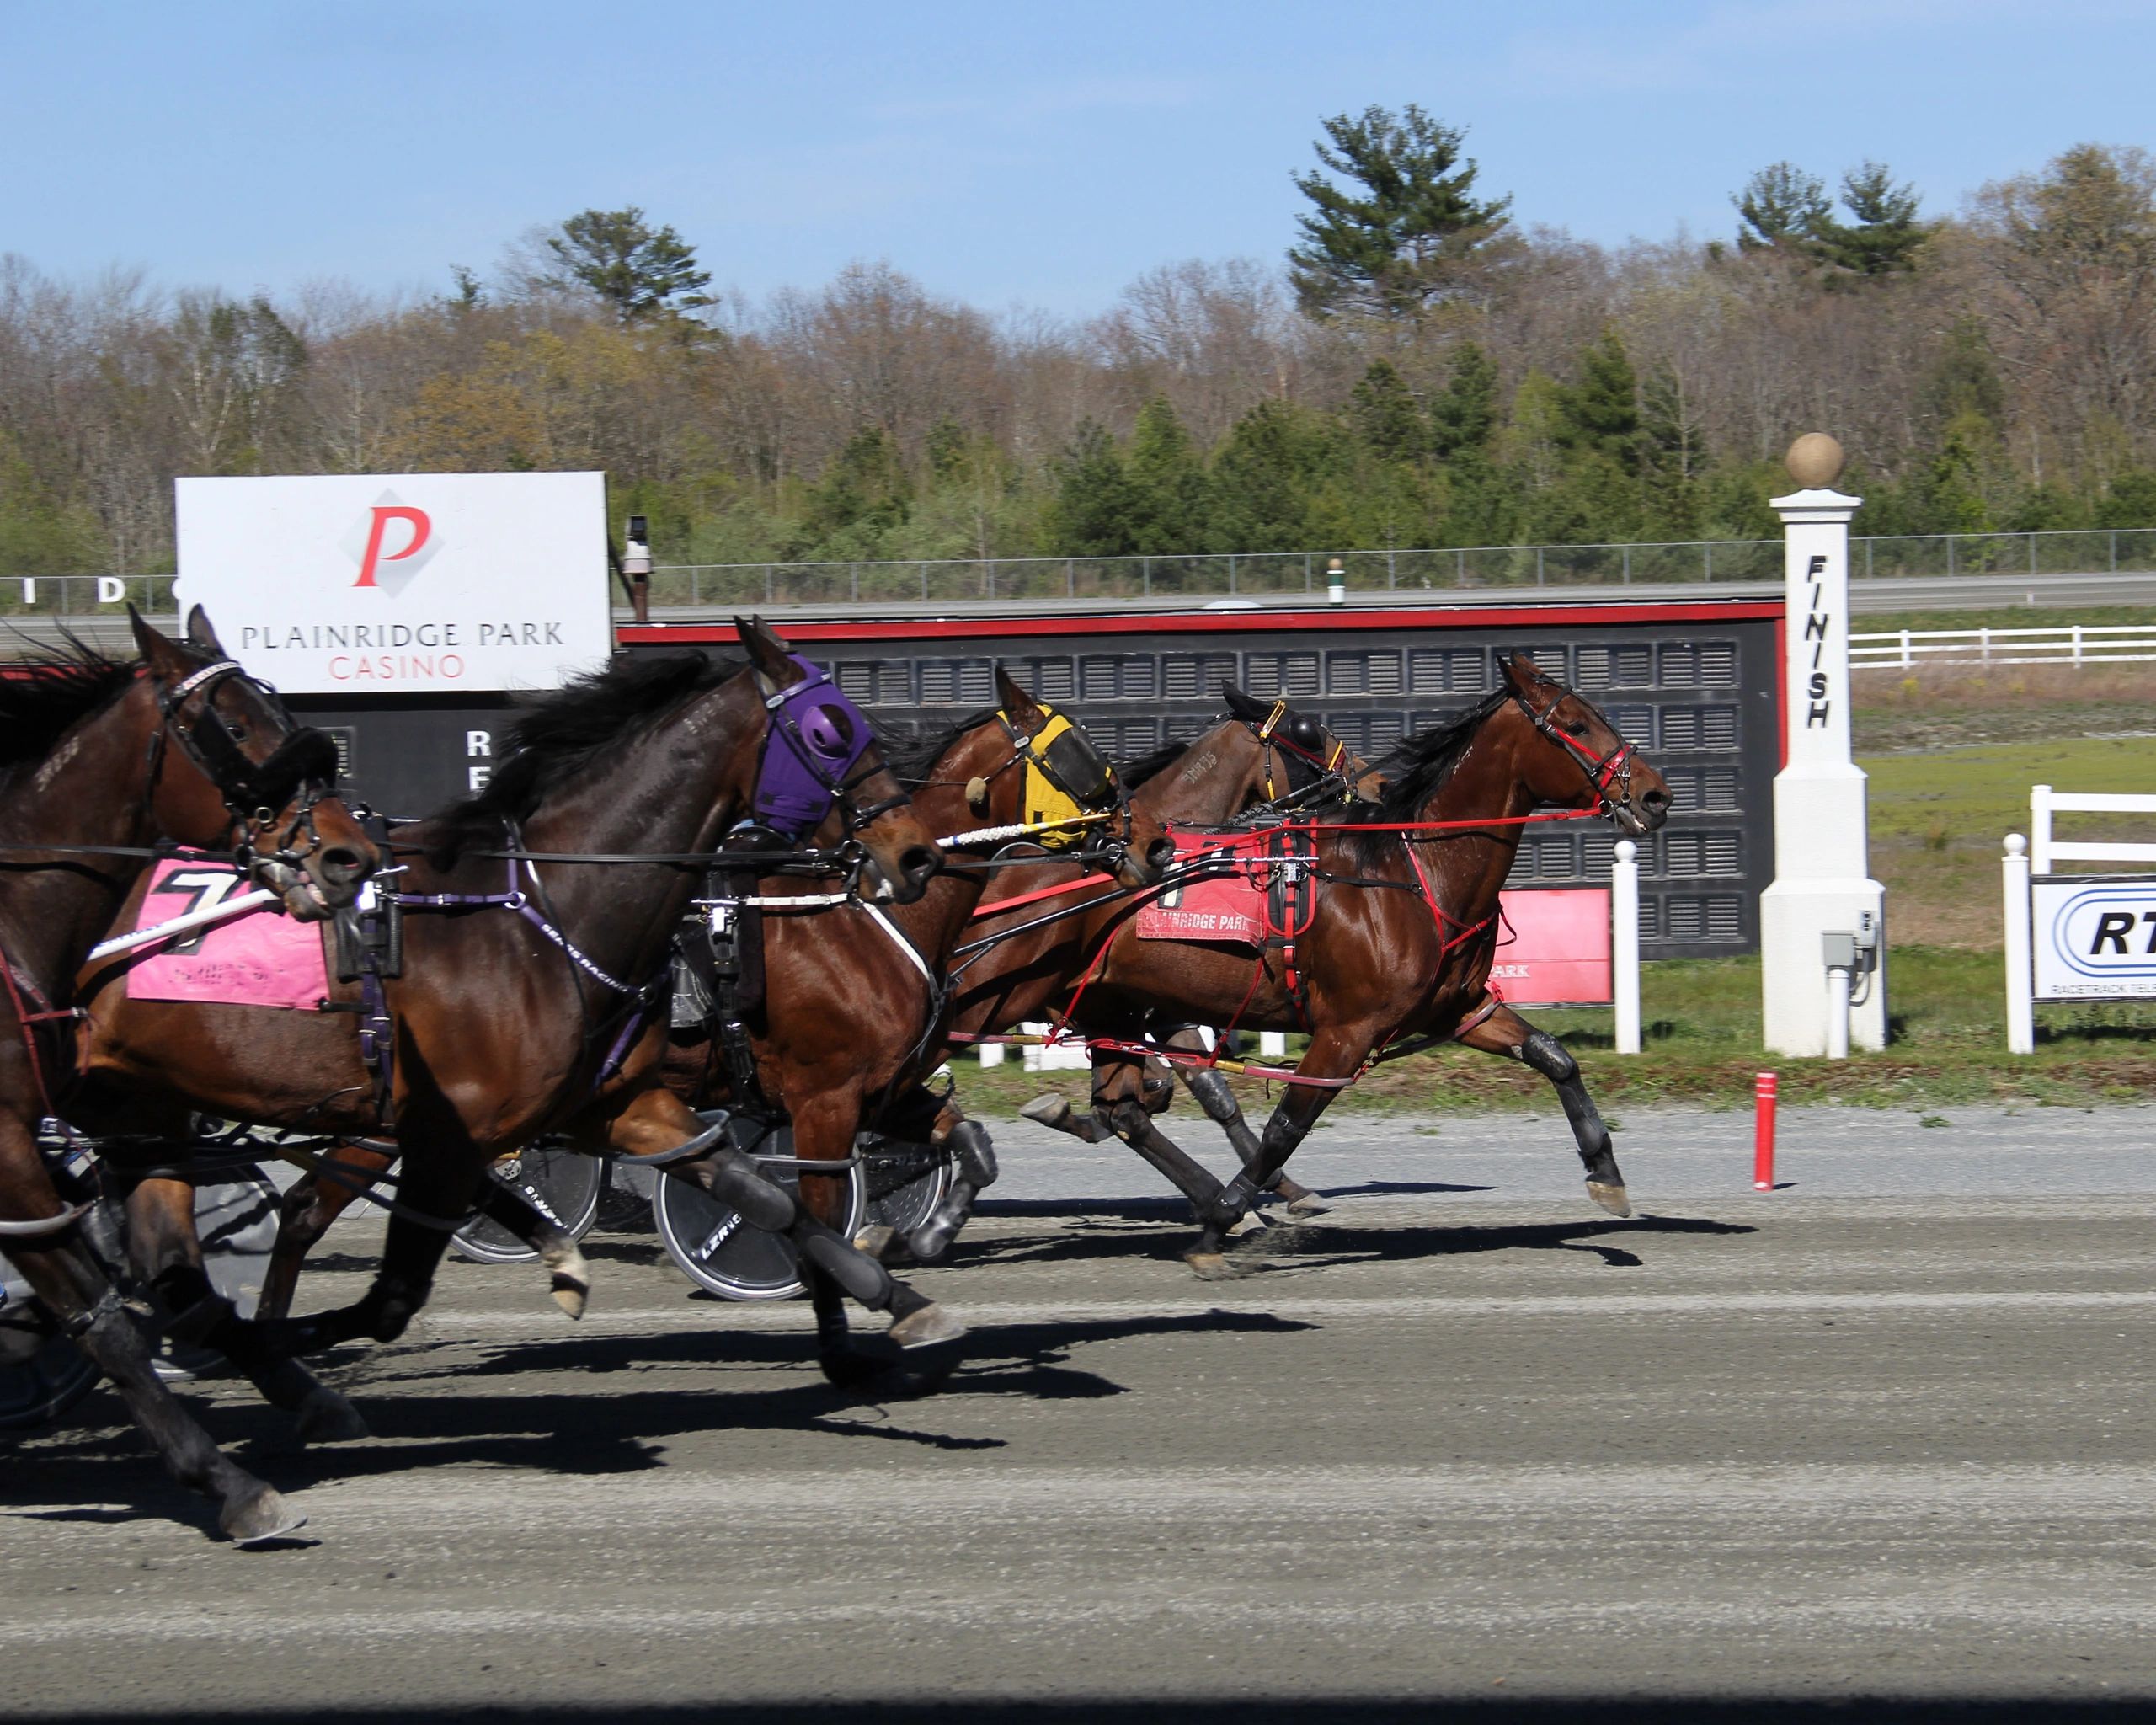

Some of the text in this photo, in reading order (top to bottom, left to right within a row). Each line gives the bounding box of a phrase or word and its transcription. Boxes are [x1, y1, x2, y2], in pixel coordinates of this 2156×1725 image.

[352, 506, 431, 587] P
[242, 622, 565, 649] PLAINRIDGE PARK
[1805, 555, 1829, 729] FINISH
[328, 654, 464, 681] CASINO
[156, 868, 241, 955] 7
[1491, 965, 1530, 978] ARK
